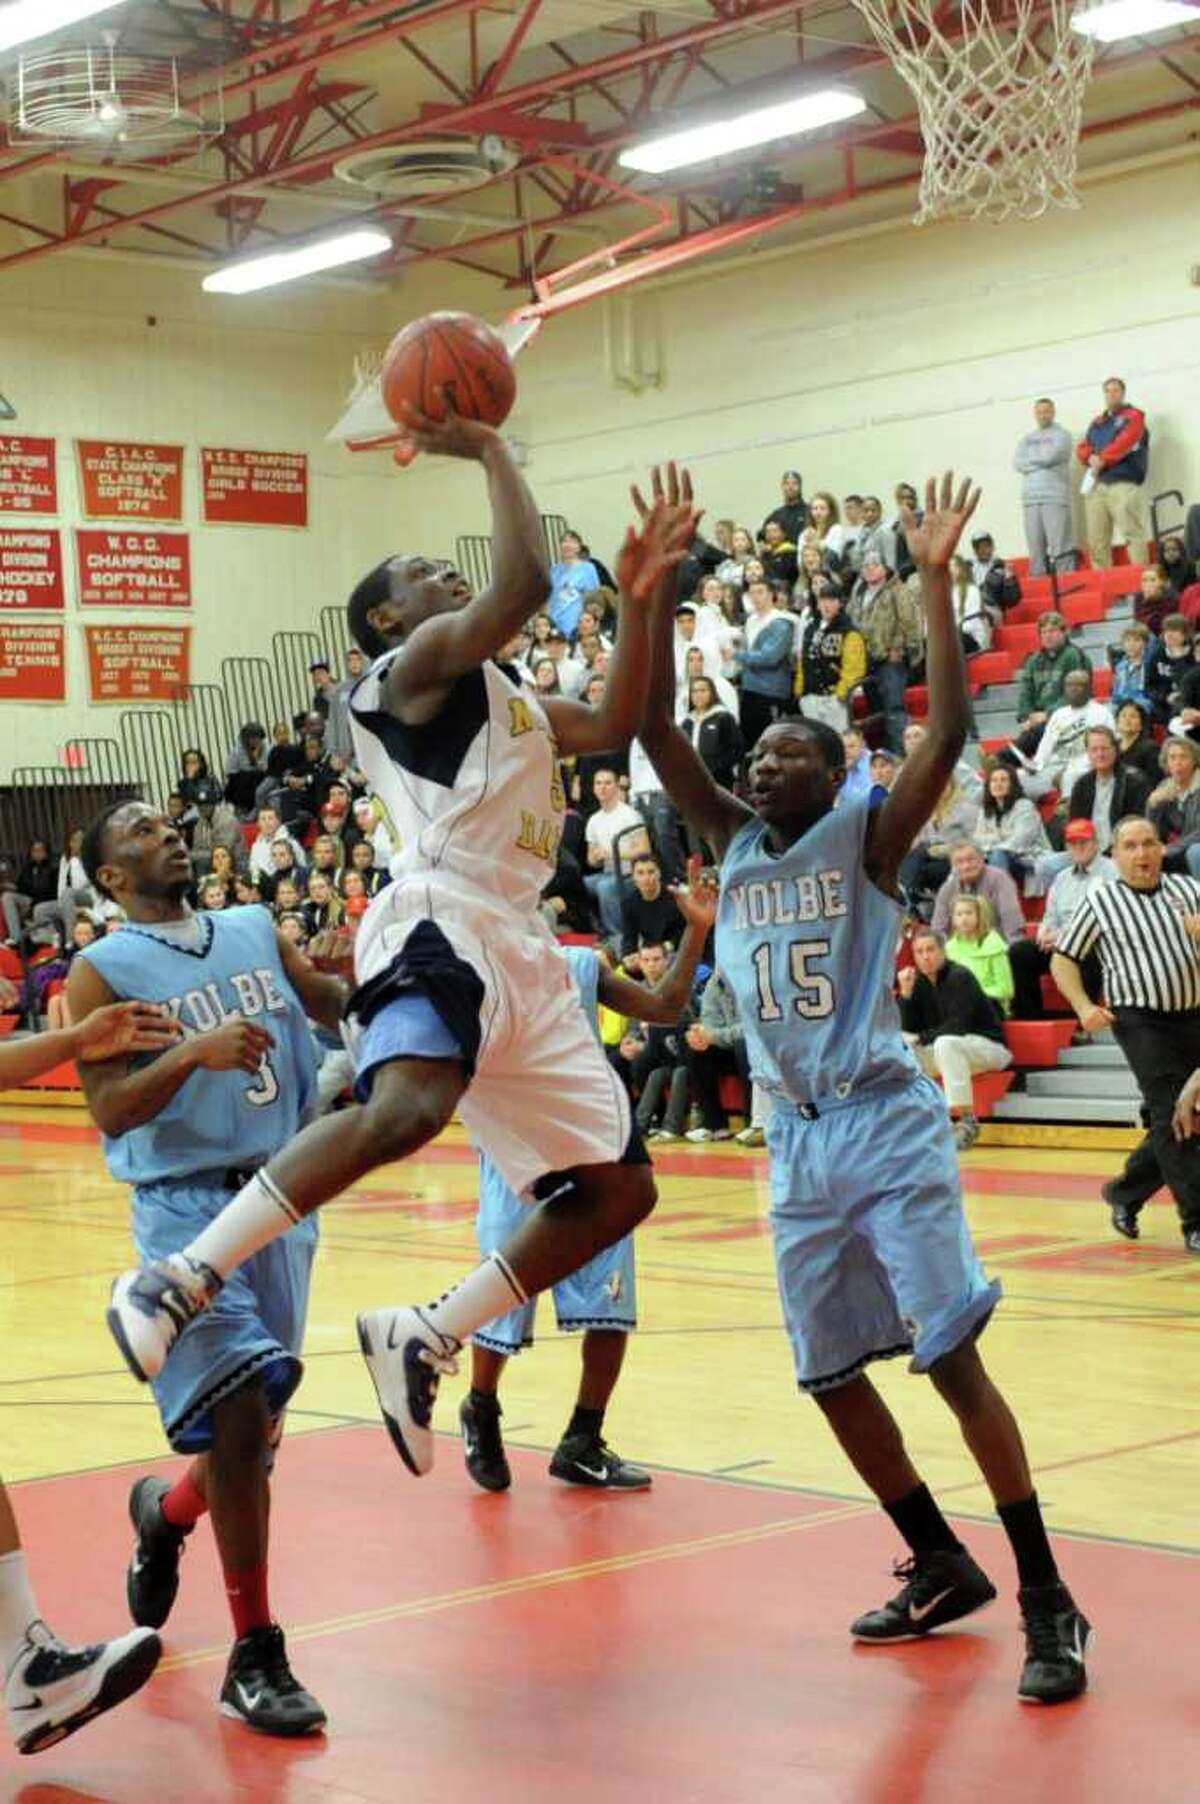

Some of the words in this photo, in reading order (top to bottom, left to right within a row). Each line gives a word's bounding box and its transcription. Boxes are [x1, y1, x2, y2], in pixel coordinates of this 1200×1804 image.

[87, 554, 182, 570] CHAMPIONS
[91, 572, 181, 588] SOFTBALL
[753, 938, 836, 1022] 15
